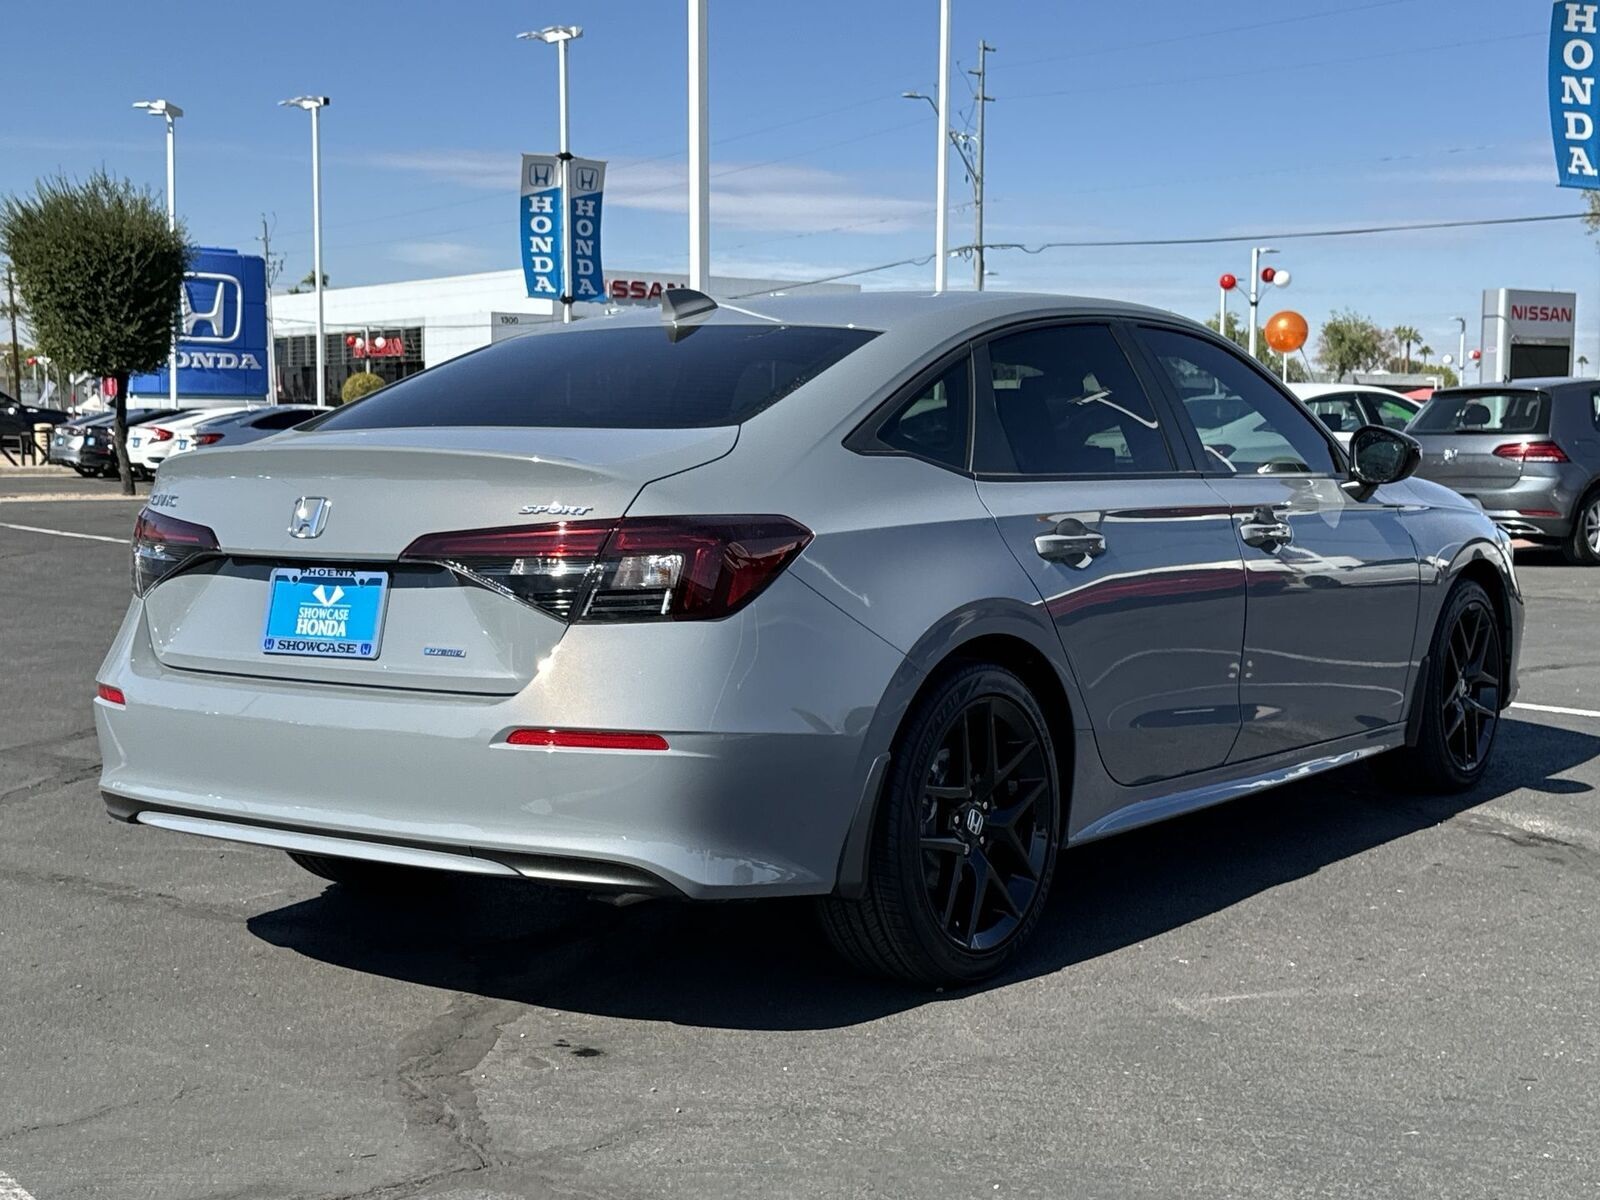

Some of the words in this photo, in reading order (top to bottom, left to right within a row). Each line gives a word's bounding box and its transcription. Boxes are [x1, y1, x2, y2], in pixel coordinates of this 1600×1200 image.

[1561, 3, 1598, 176] HONDA
[529, 196, 556, 293] HONDA
[575, 199, 598, 295] HONDA
[1511, 304, 1572, 322] NISSAN
[176, 352, 263, 370] ONDA
[518, 502, 594, 516] SPORT
[299, 568, 357, 577] PHOENIX
[299, 607, 350, 620] SHOWCASE
[295, 618, 347, 637] HONDA
[277, 640, 358, 654] SHOWCASE
